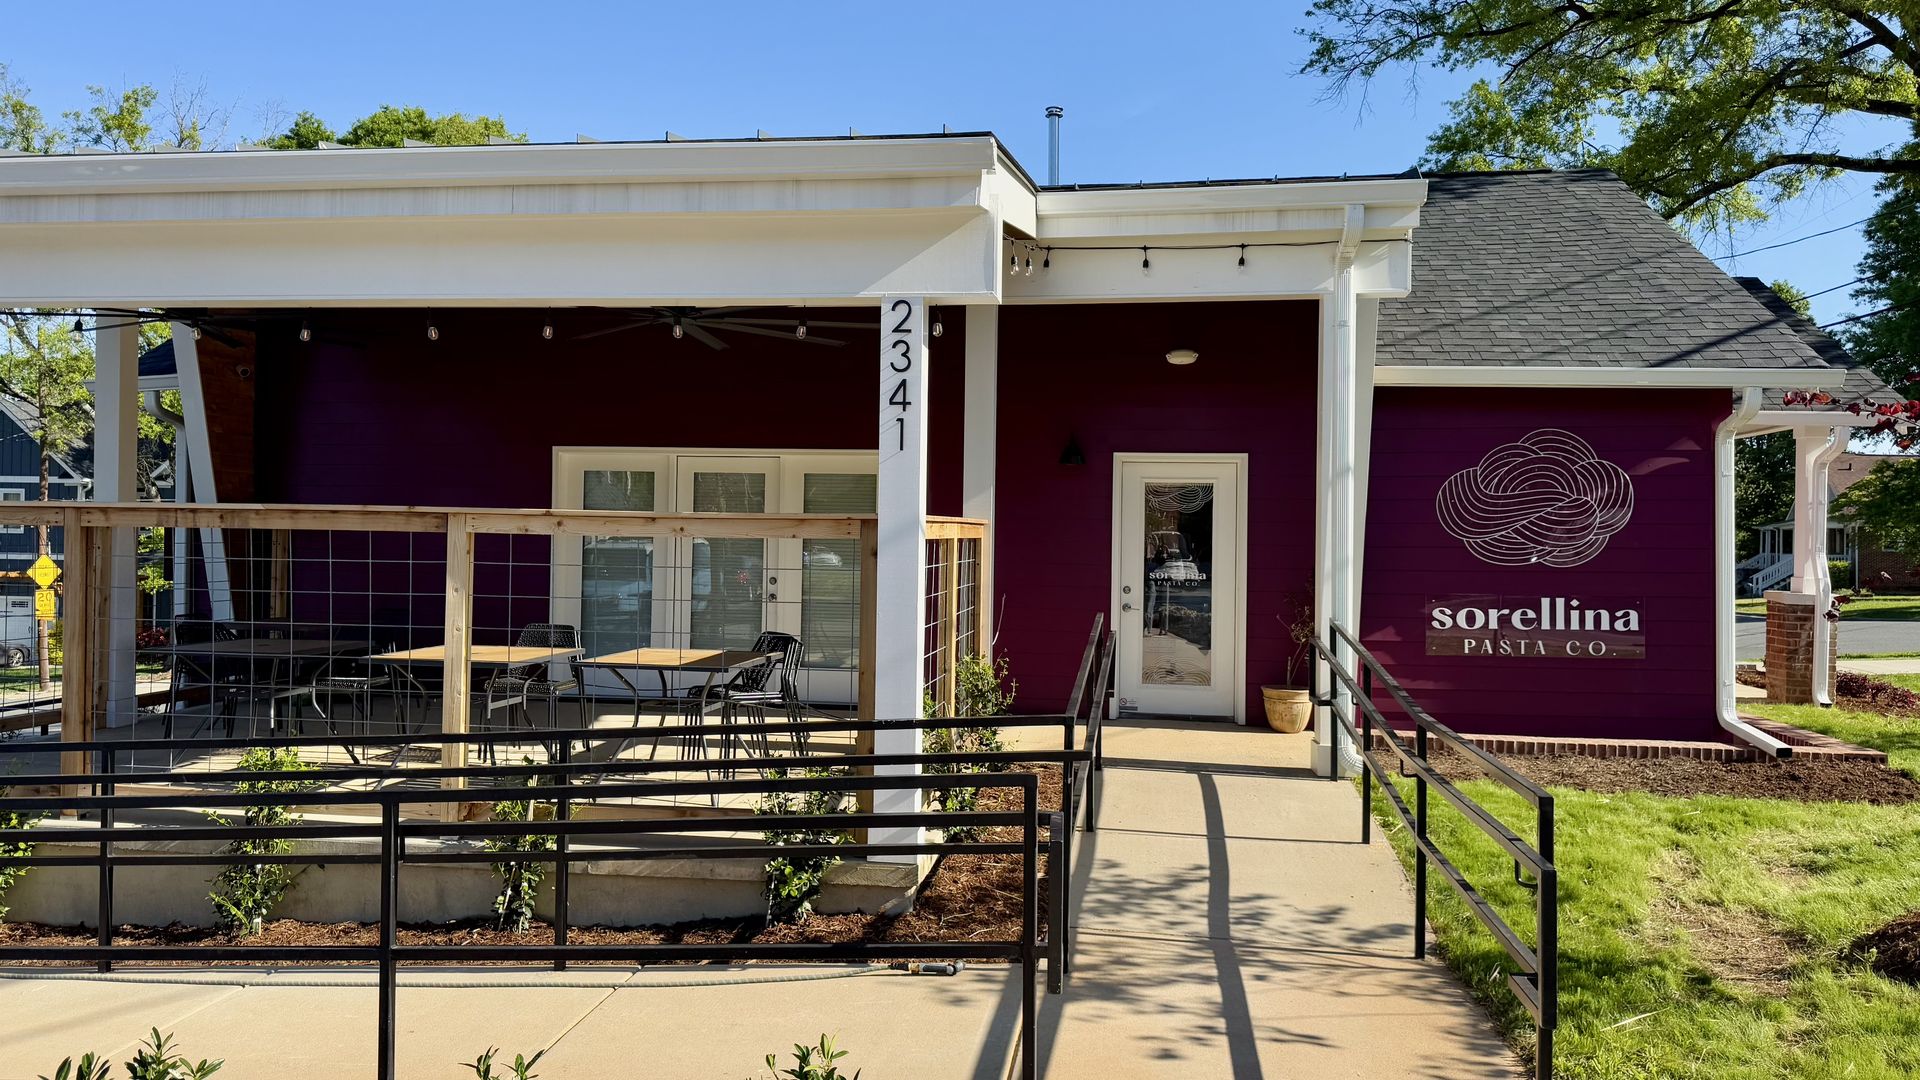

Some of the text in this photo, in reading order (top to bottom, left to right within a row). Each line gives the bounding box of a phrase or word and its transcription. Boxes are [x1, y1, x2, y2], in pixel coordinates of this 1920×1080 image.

[889, 300, 912, 451] 2341
[37, 592, 52, 602] 20
[1431, 597, 1640, 631] sorellina
[1463, 639, 1617, 657] PASTA CO.
